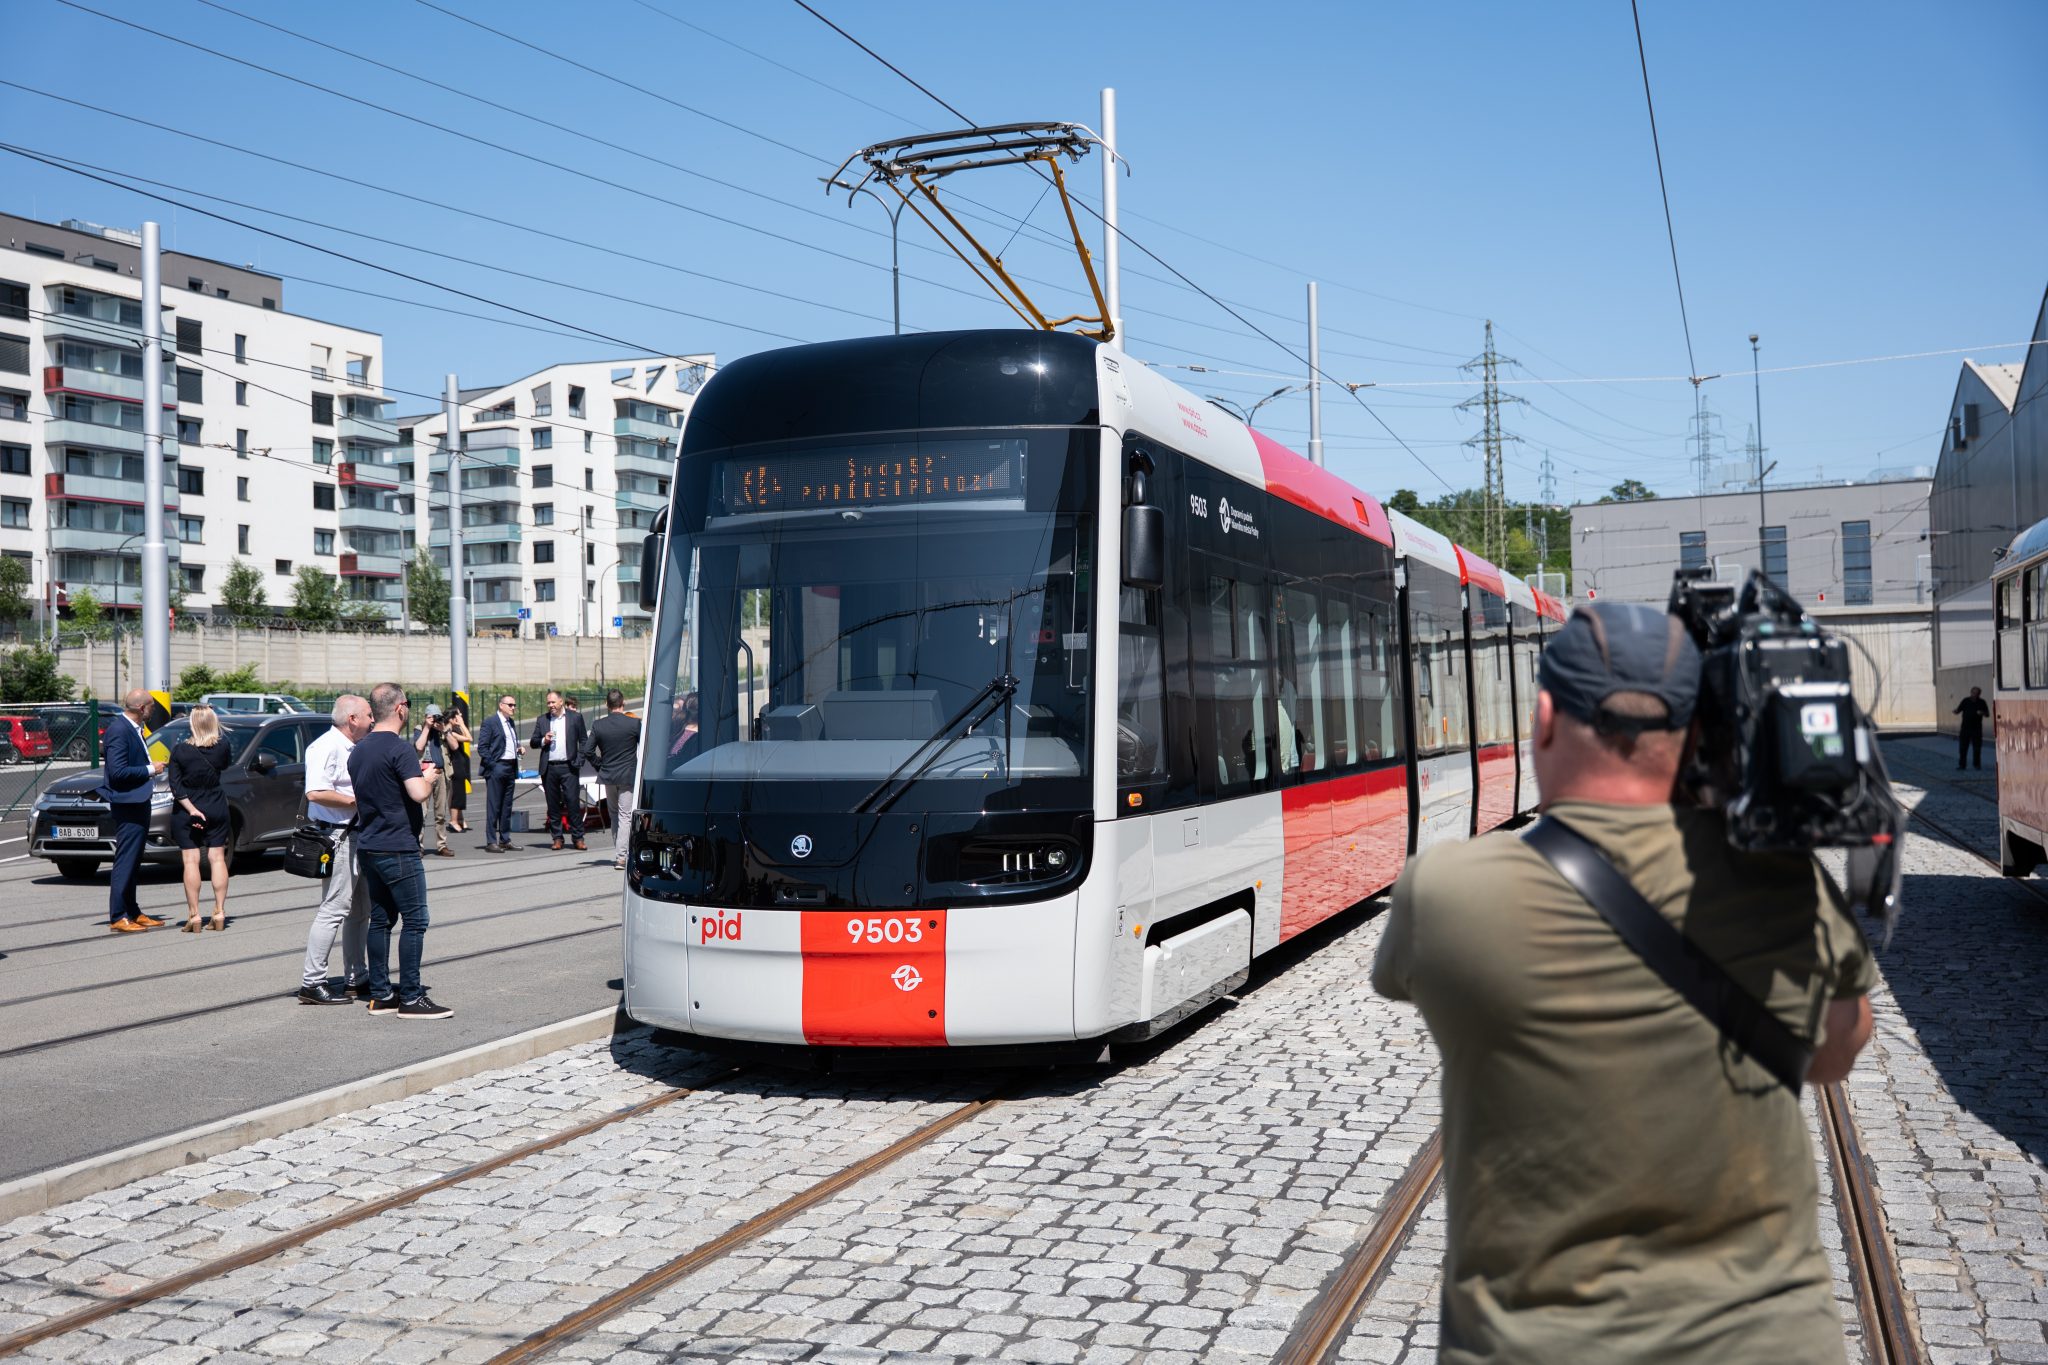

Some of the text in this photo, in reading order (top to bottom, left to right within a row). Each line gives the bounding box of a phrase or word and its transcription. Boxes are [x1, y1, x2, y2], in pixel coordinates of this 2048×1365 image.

[1190, 494, 1208, 519] 9503
[59, 828, 95, 837] 8AB 6300
[701, 910, 742, 944] pid
[847, 918, 923, 944] 9503
